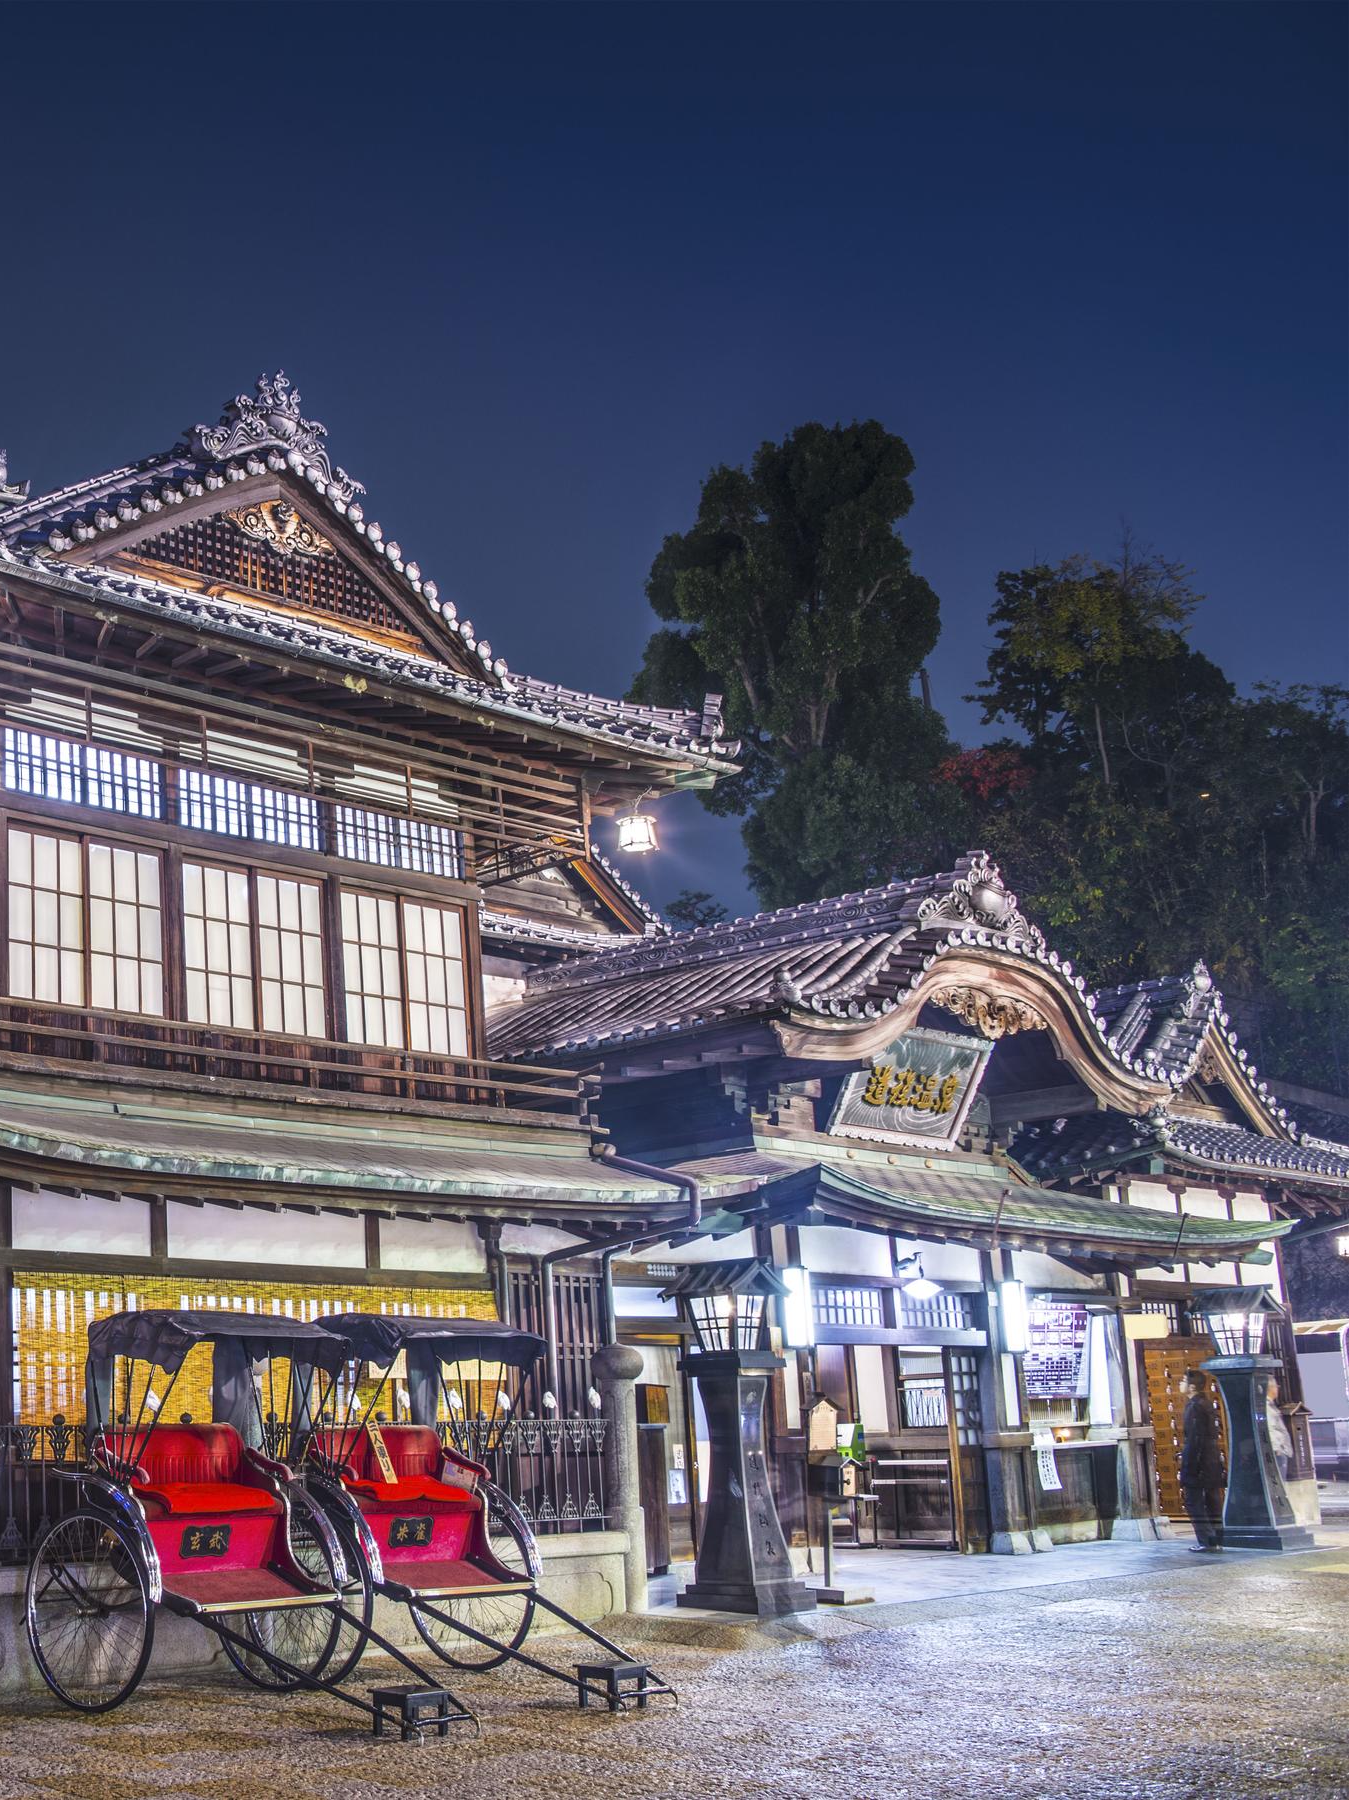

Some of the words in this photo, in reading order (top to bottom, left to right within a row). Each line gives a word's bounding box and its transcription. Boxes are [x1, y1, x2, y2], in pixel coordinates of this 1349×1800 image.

[863, 1064, 958, 1114] 道後温泉
[190, 1531, 228, 1550] 玄武
[396, 1522, 426, 1541] 朱雀
